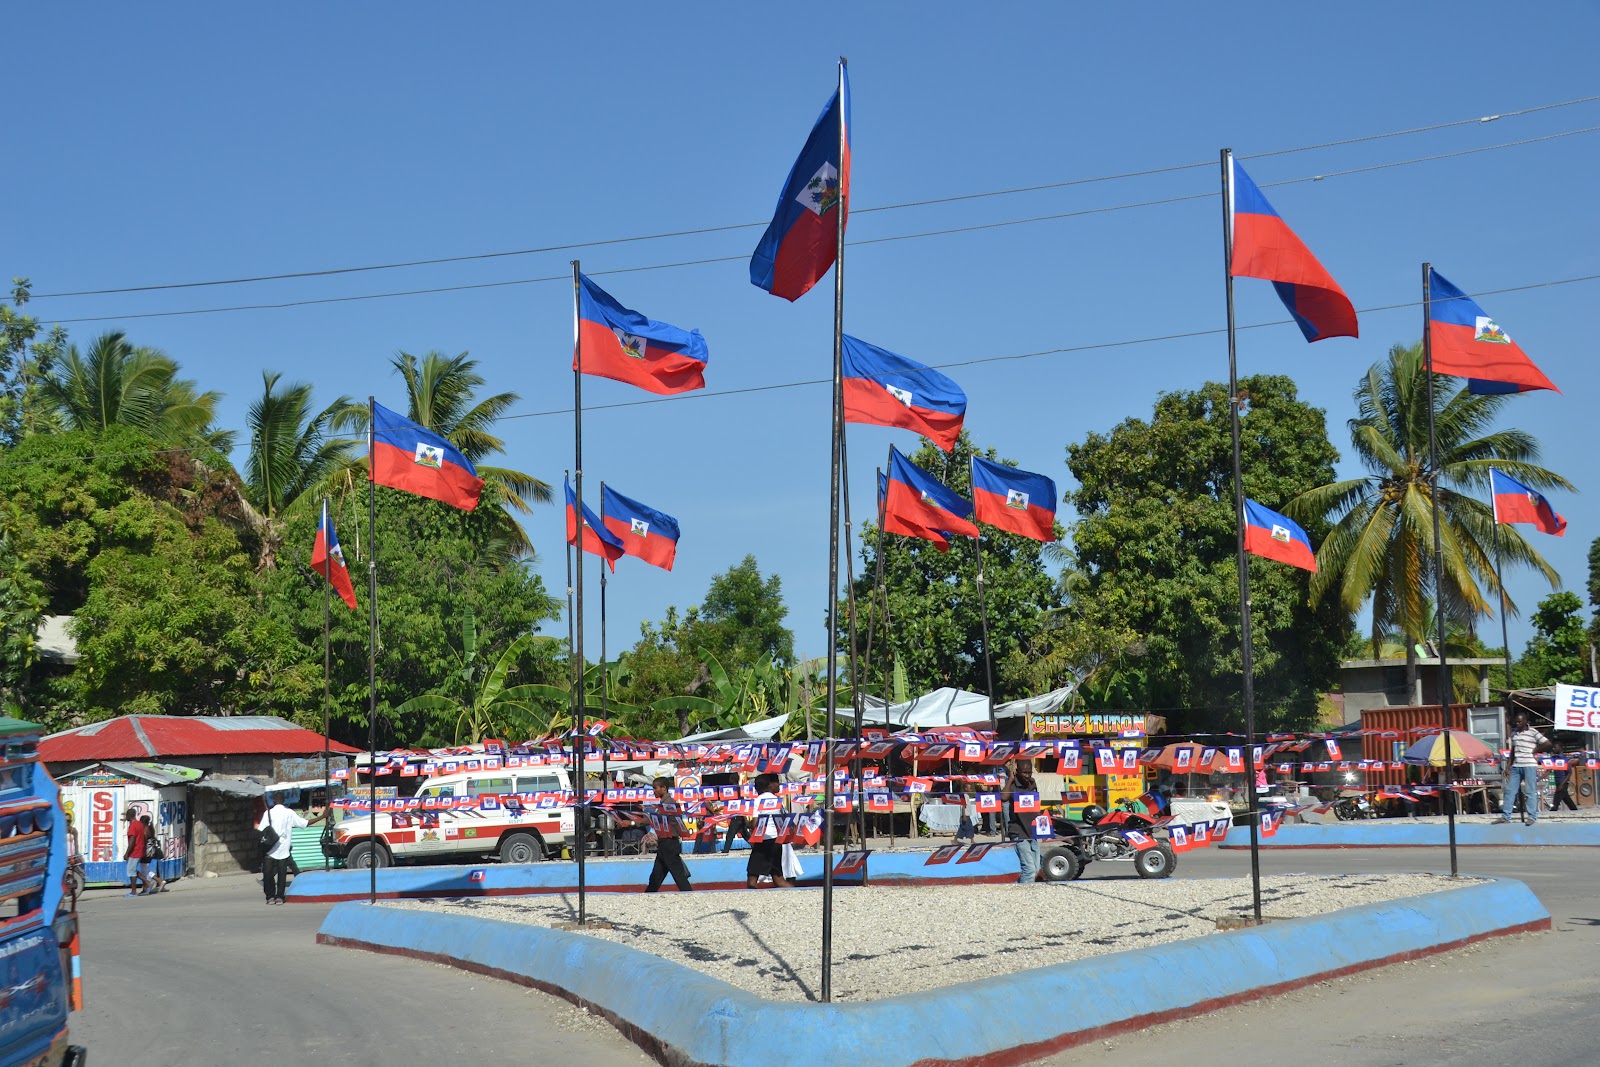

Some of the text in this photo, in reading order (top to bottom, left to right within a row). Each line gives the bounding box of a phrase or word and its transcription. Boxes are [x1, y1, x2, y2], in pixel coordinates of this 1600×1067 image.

[1031, 714, 1145, 733] CHEZ TITON
[92, 791, 114, 862] SUPER
